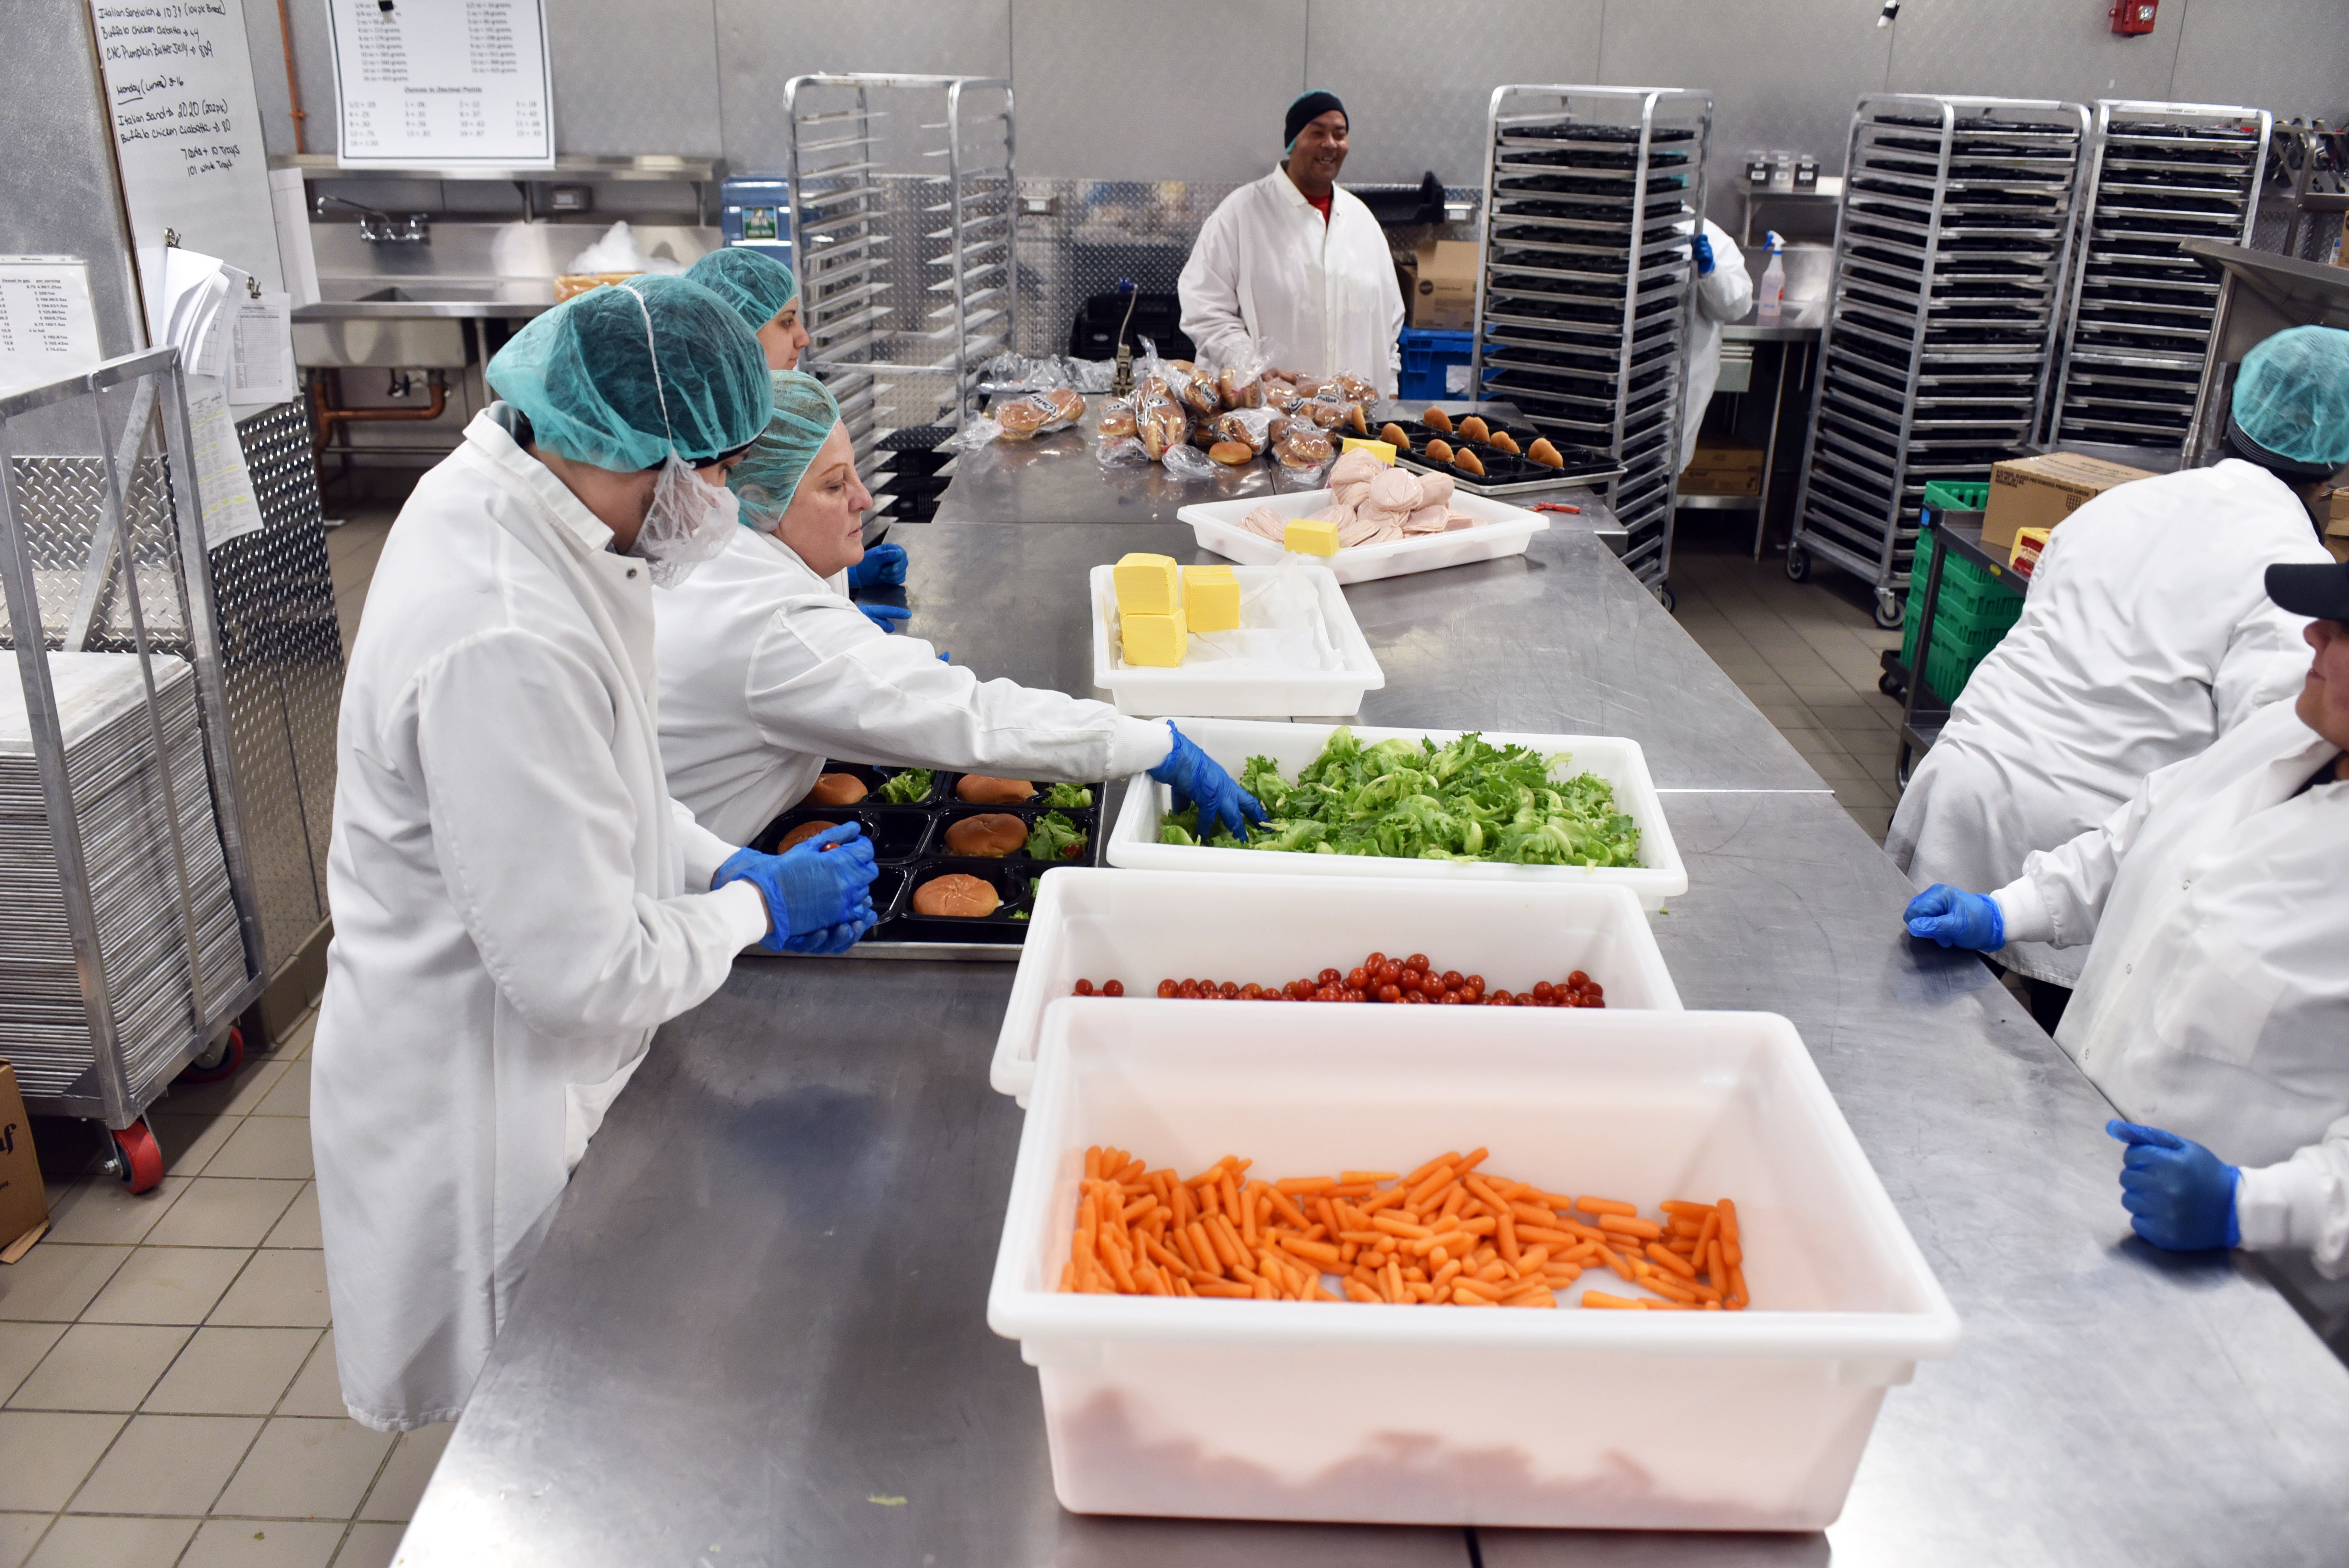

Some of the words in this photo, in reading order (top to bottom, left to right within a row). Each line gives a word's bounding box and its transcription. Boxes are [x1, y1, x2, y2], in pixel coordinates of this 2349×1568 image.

[98, 7, 125, 19] Italian
[101, 26, 130, 39] Buffalo
[132, 25, 155, 34] Chicken
[121, 44, 153, 59] Pumpkin
[116, 83, 141, 96] Monday
[118, 114, 145, 127] Italian
[178, 101, 200, 118] 2020
[120, 128, 150, 145] Buffalo
[151, 127, 178, 138] Chicken
[179, 123, 211, 135] Ciabatta
[221, 118, 231, 134] 80
[187, 165, 198, 178] 101
[2055, 483, 2073, 493] PROCESS
[2074, 488, 2089, 497] CHEESE
